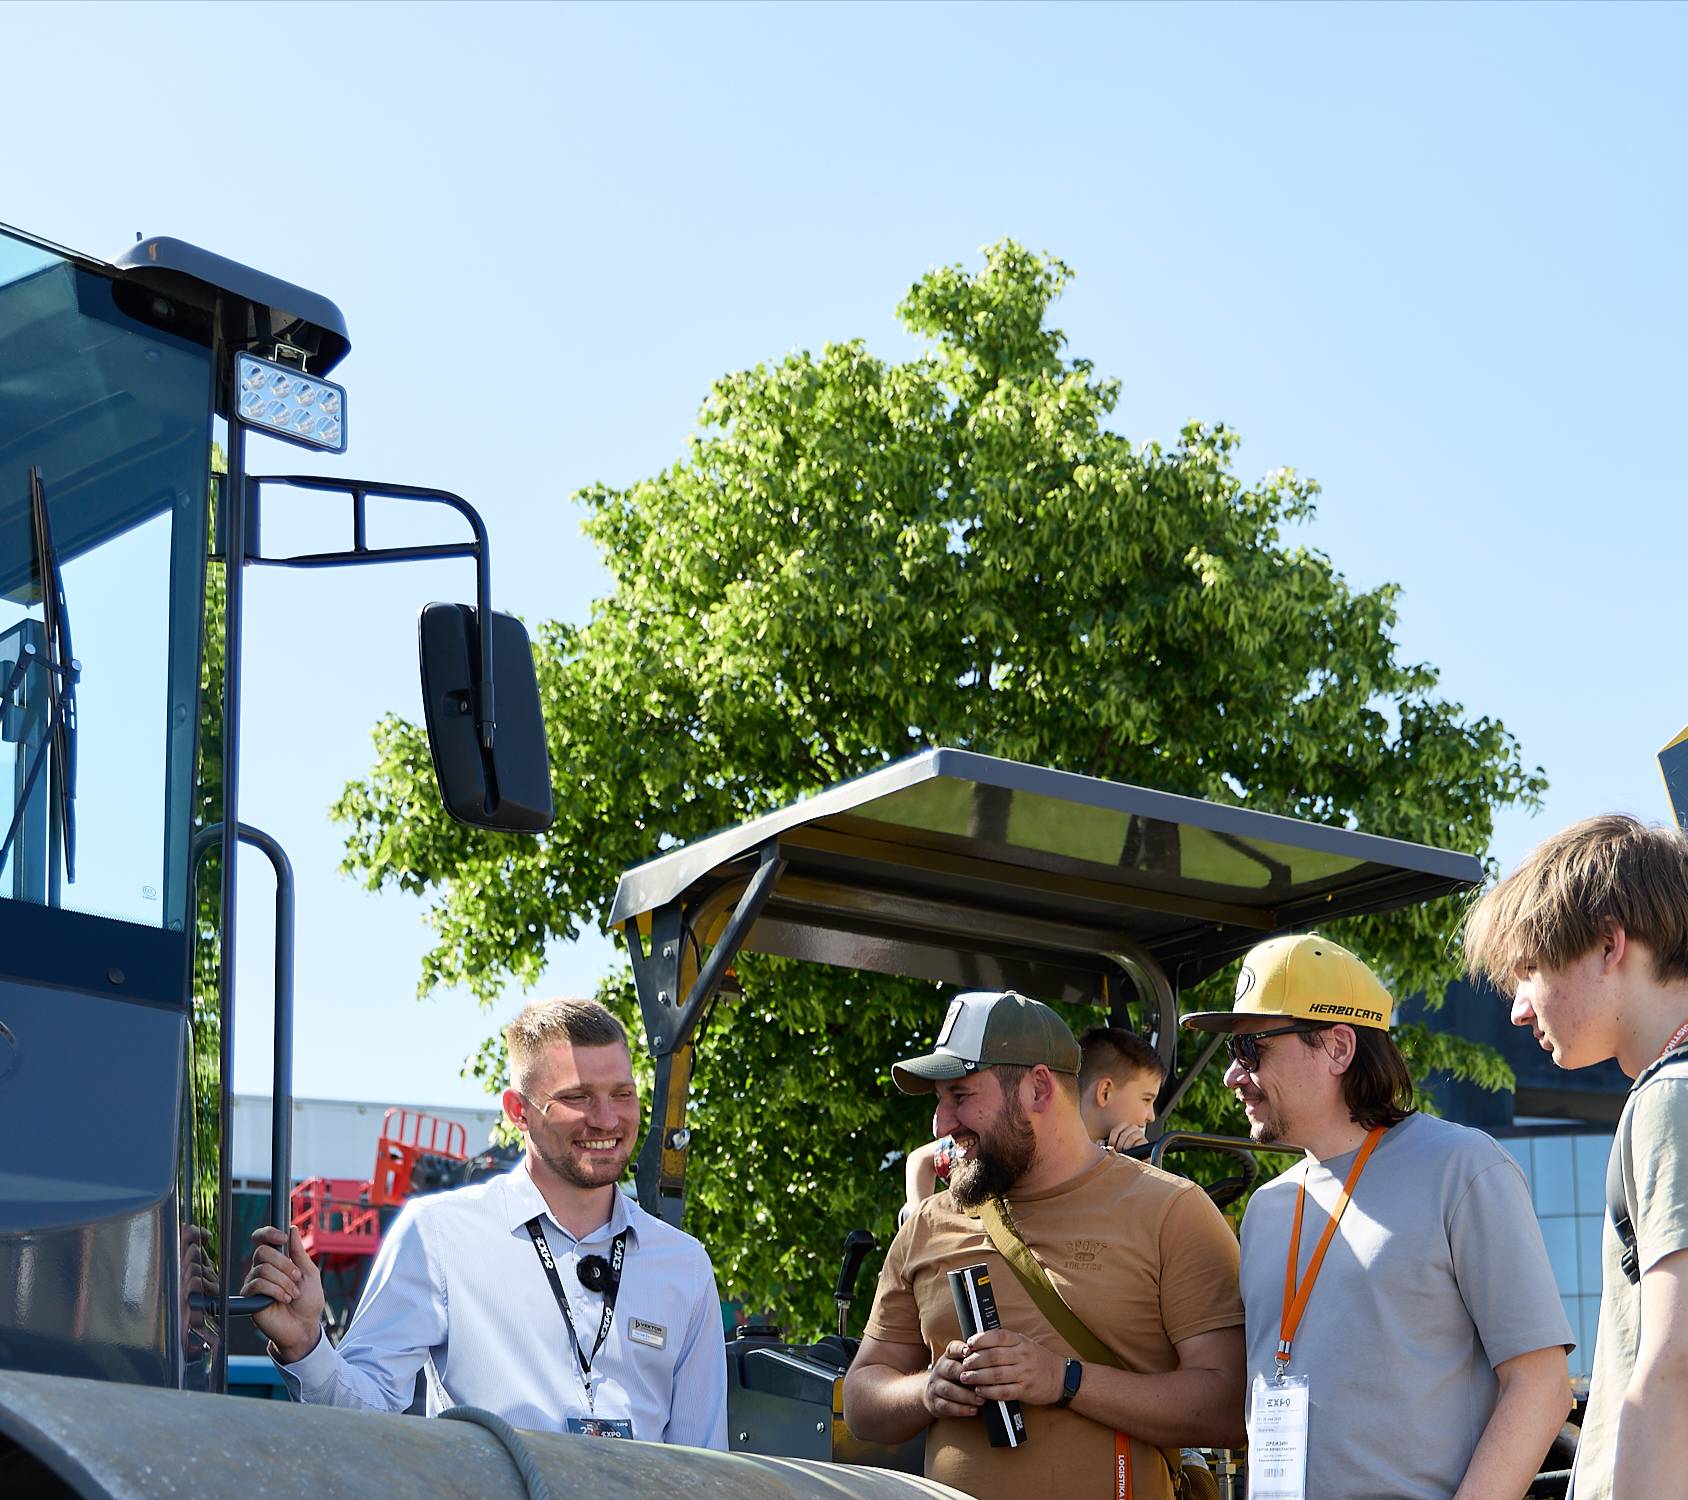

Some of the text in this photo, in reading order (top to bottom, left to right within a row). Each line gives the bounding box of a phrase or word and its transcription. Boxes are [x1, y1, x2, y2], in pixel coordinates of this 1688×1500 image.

[1355, 1008, 1383, 1022] CATS
[535, 1236, 554, 1270] EXPO
[612, 1239, 625, 1271] EXPO
[1266, 1398, 1291, 1407] EXPO
